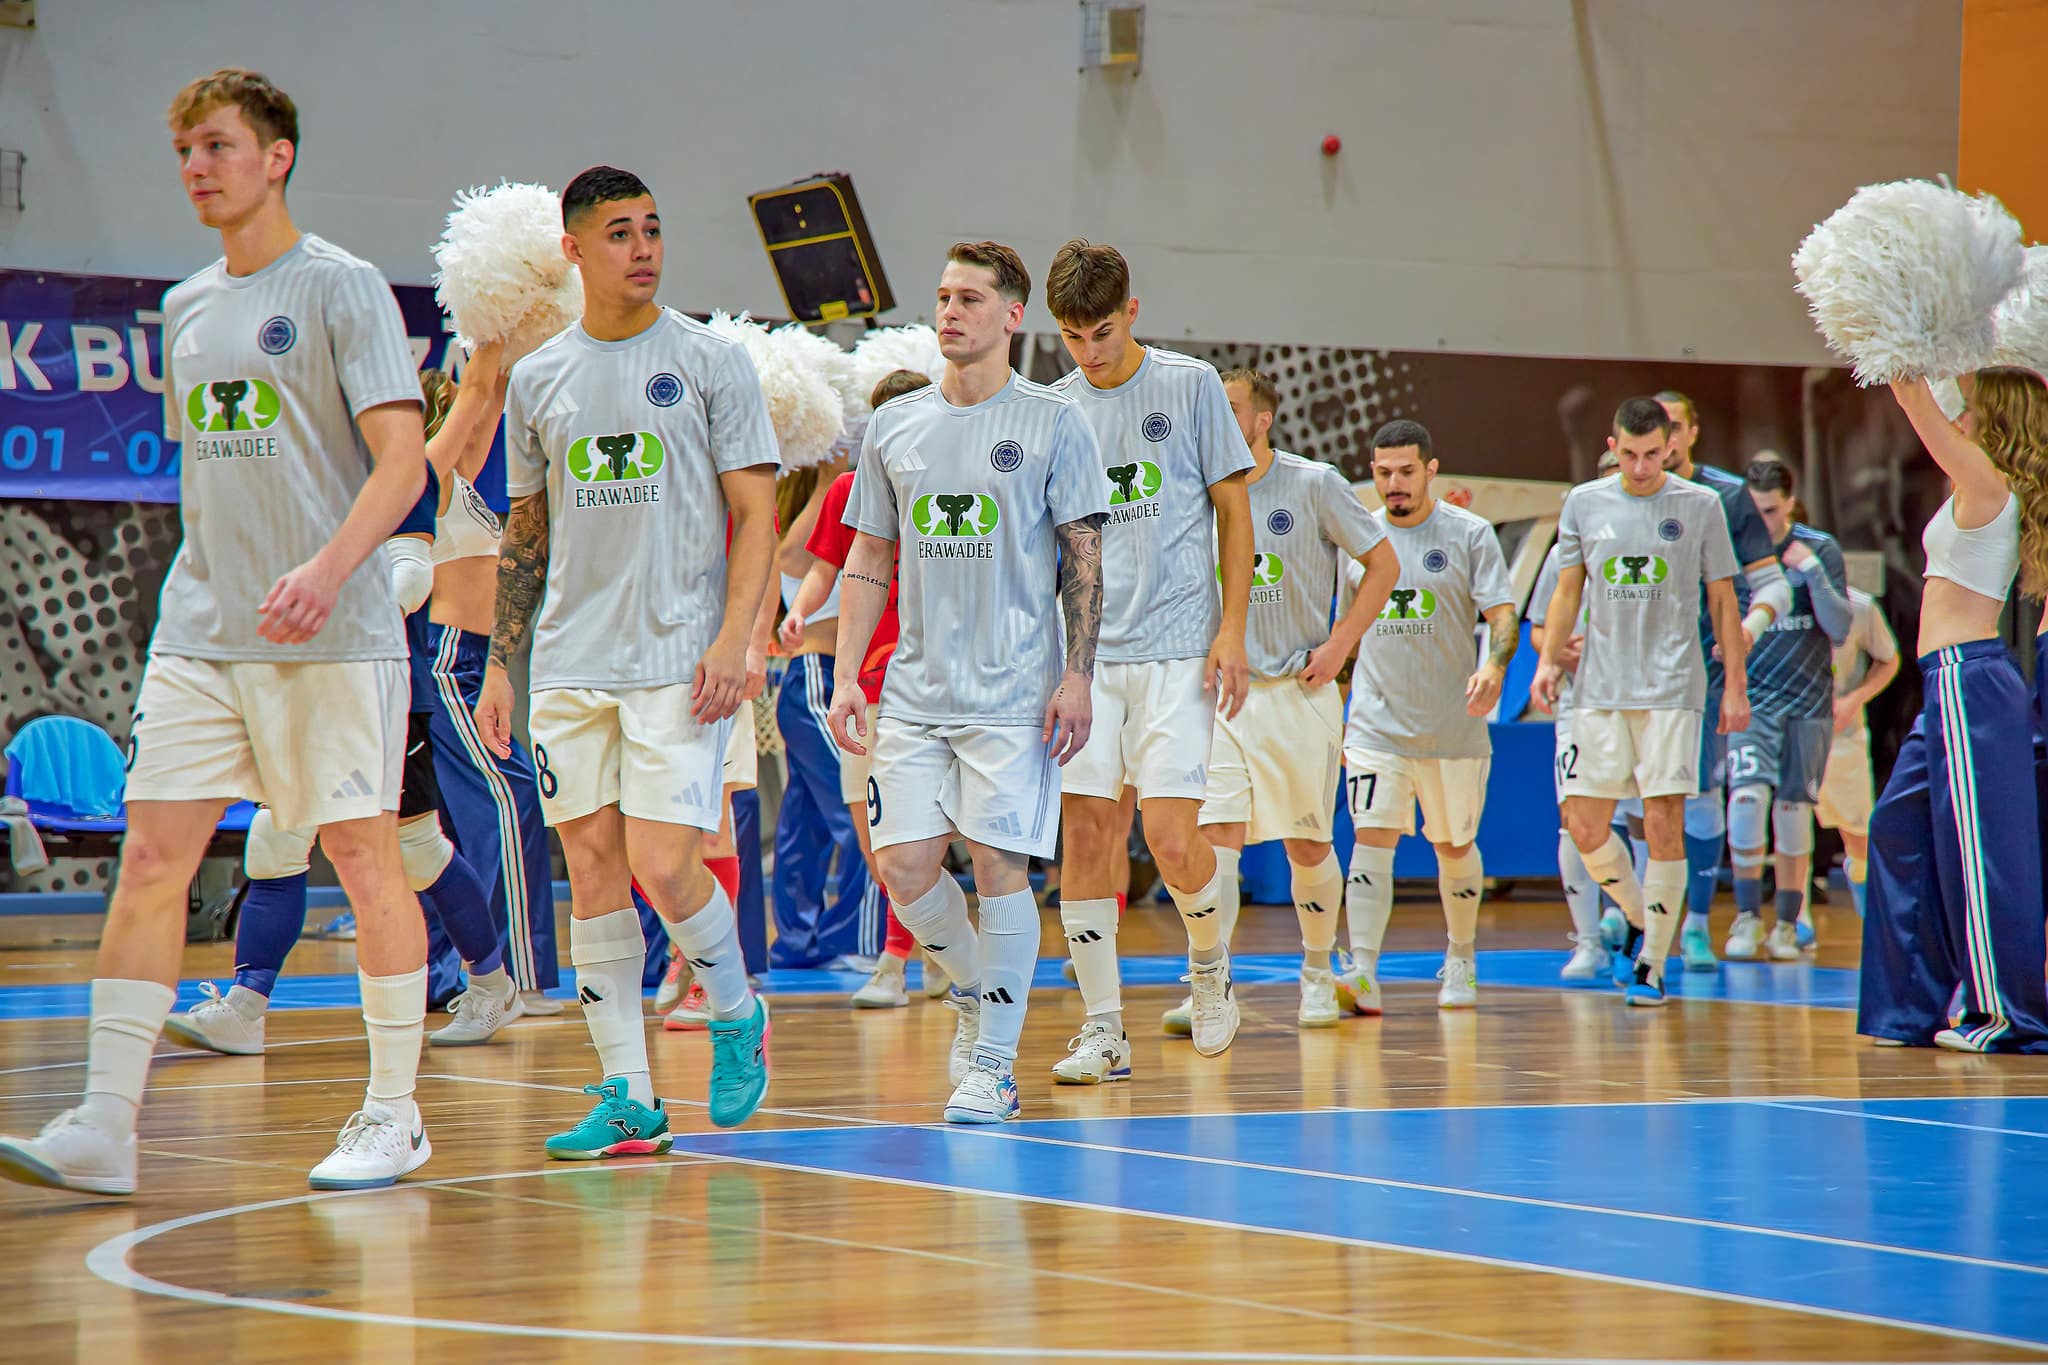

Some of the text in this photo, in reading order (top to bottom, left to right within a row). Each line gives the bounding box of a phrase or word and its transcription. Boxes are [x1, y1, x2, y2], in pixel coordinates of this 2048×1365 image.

[2, 424, 65, 473] 01
[575, 484, 660, 508] ERAWADEE
[918, 541, 993, 559] ERAWADEE
[1607, 588, 1662, 601] ERAWADEE
[1376, 623, 1433, 636] ERAWADEE
[535, 743, 558, 799] 8
[1727, 745, 1758, 778] 25
[867, 775, 882, 827] 9
[1348, 773, 1377, 815] 17
